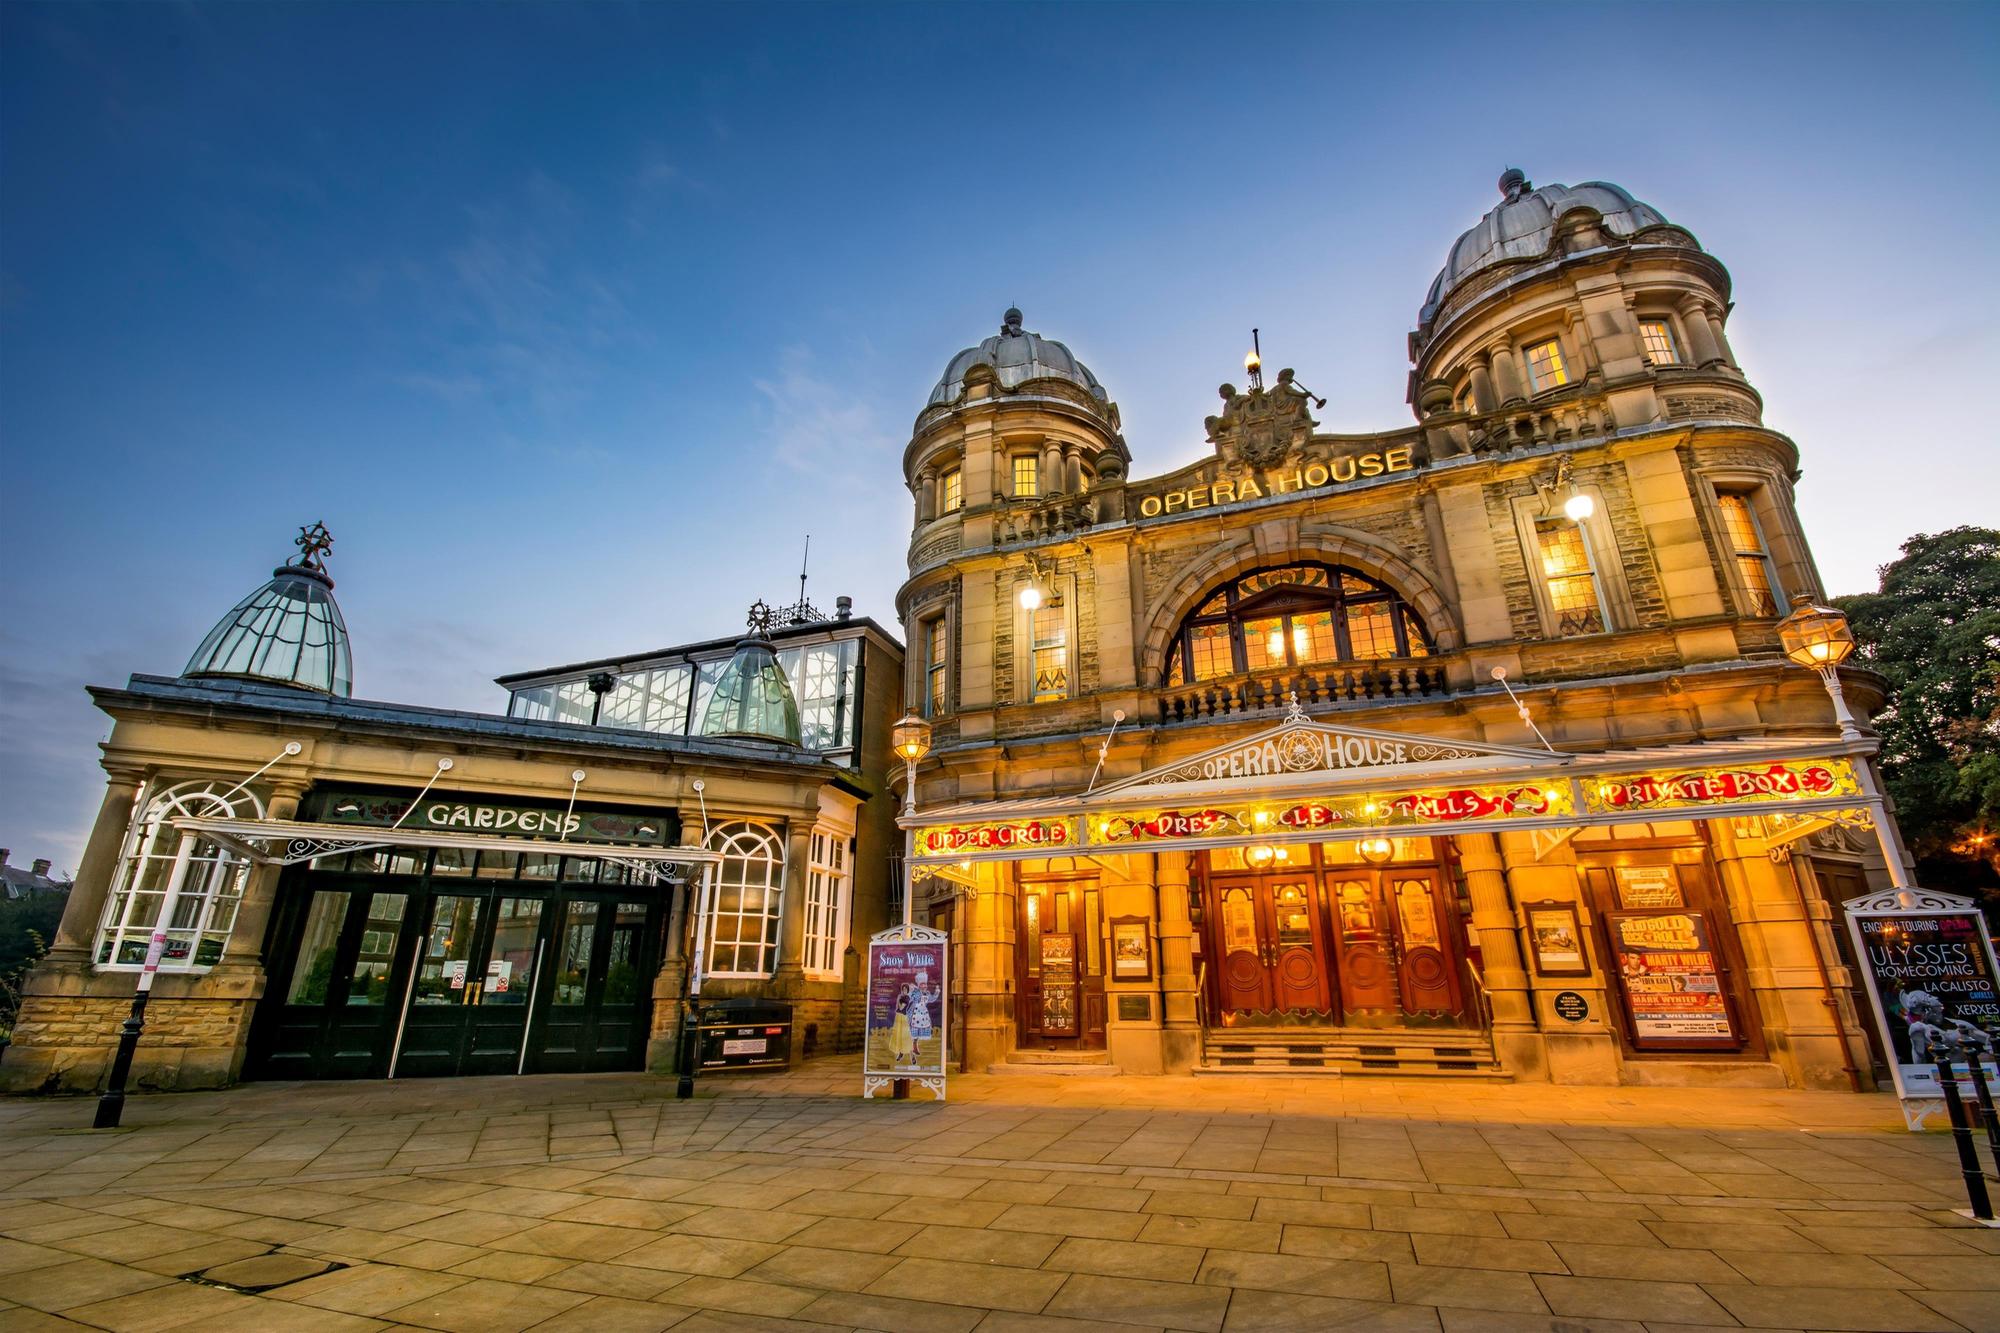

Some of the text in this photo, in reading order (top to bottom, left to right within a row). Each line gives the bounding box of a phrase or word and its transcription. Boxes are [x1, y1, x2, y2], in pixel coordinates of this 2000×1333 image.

[1140, 447, 1413, 517] OPERA HOUSE
[1203, 733, 1408, 778] OPERA HOUSE
[1604, 770, 1834, 805] PRIVATE BOXES
[427, 804, 581, 833] GARDENS
[1157, 815, 1229, 834] DRESS
[1236, 807, 1325, 828] CRCLE
[1378, 795, 1480, 819] STALLS
[931, 823, 1063, 849] UPPER CIRCLE
[1861, 921, 1900, 933] ENGLISH
[1900, 920, 1939, 932] TOURING
[1869, 943, 1968, 966] ULYSSES'
[1875, 964, 1974, 978] HOMECOMING
[1923, 980, 1991, 993] LA CALISTO
[1955, 1003, 2000, 1016] XERXES
